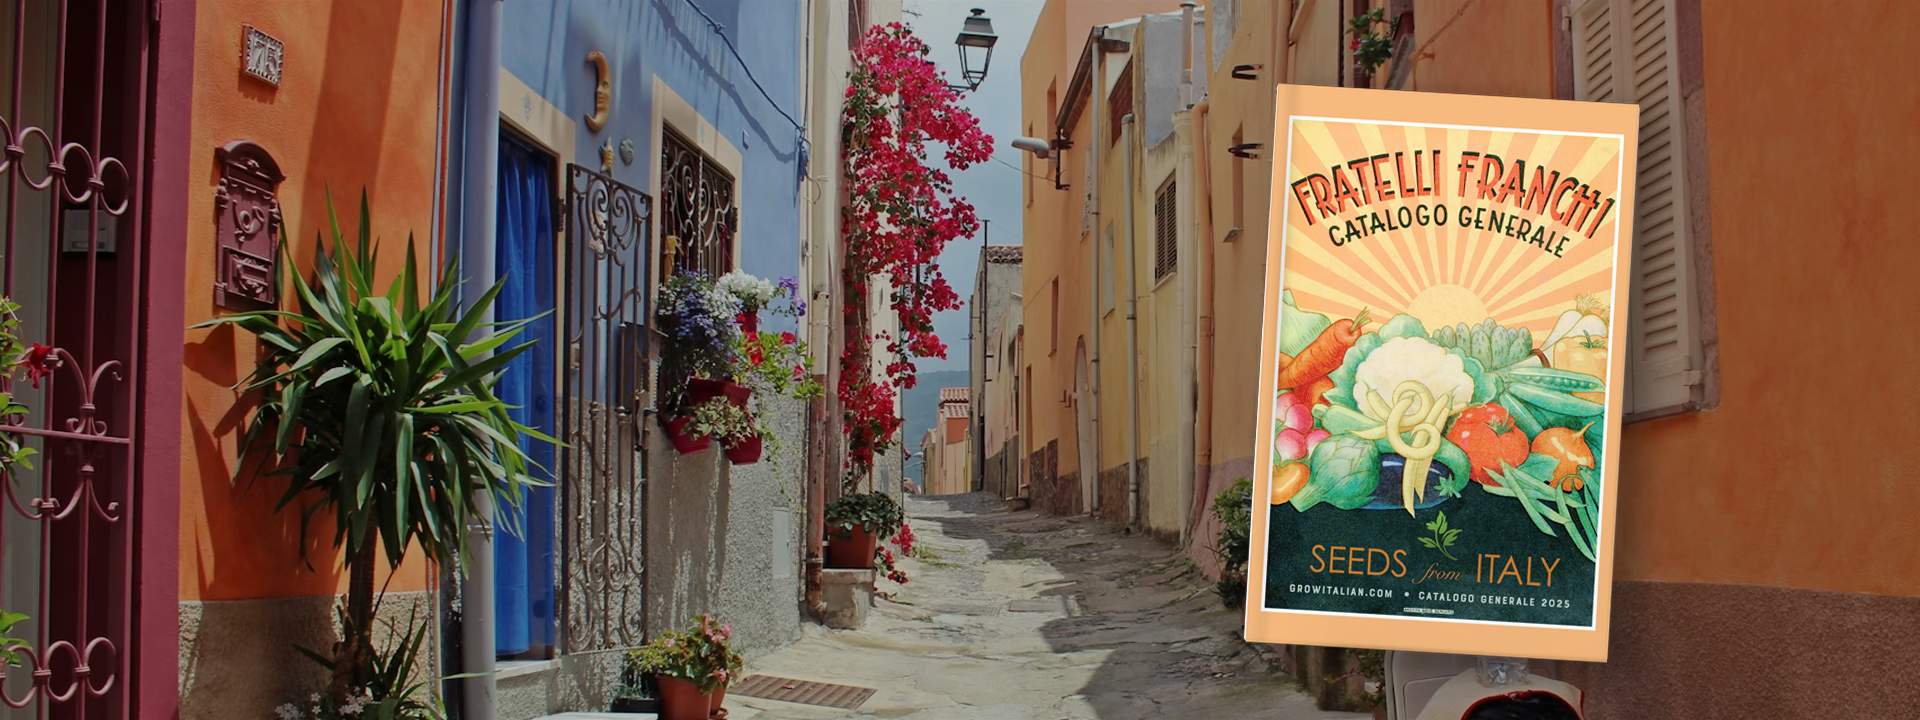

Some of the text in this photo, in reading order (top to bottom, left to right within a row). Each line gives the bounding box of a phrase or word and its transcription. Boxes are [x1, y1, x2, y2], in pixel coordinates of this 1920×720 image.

[253, 38, 277, 76] 75
[1291, 149, 1616, 240] FRATELLI FRANCHI
[1328, 203, 1571, 259] CATALOGO GENERALE
[1309, 544, 1561, 587] SEEDS from ITALY
[1289, 583, 1571, 609] GROWITALIAN.COM CATALOGO GENERALE 2025
